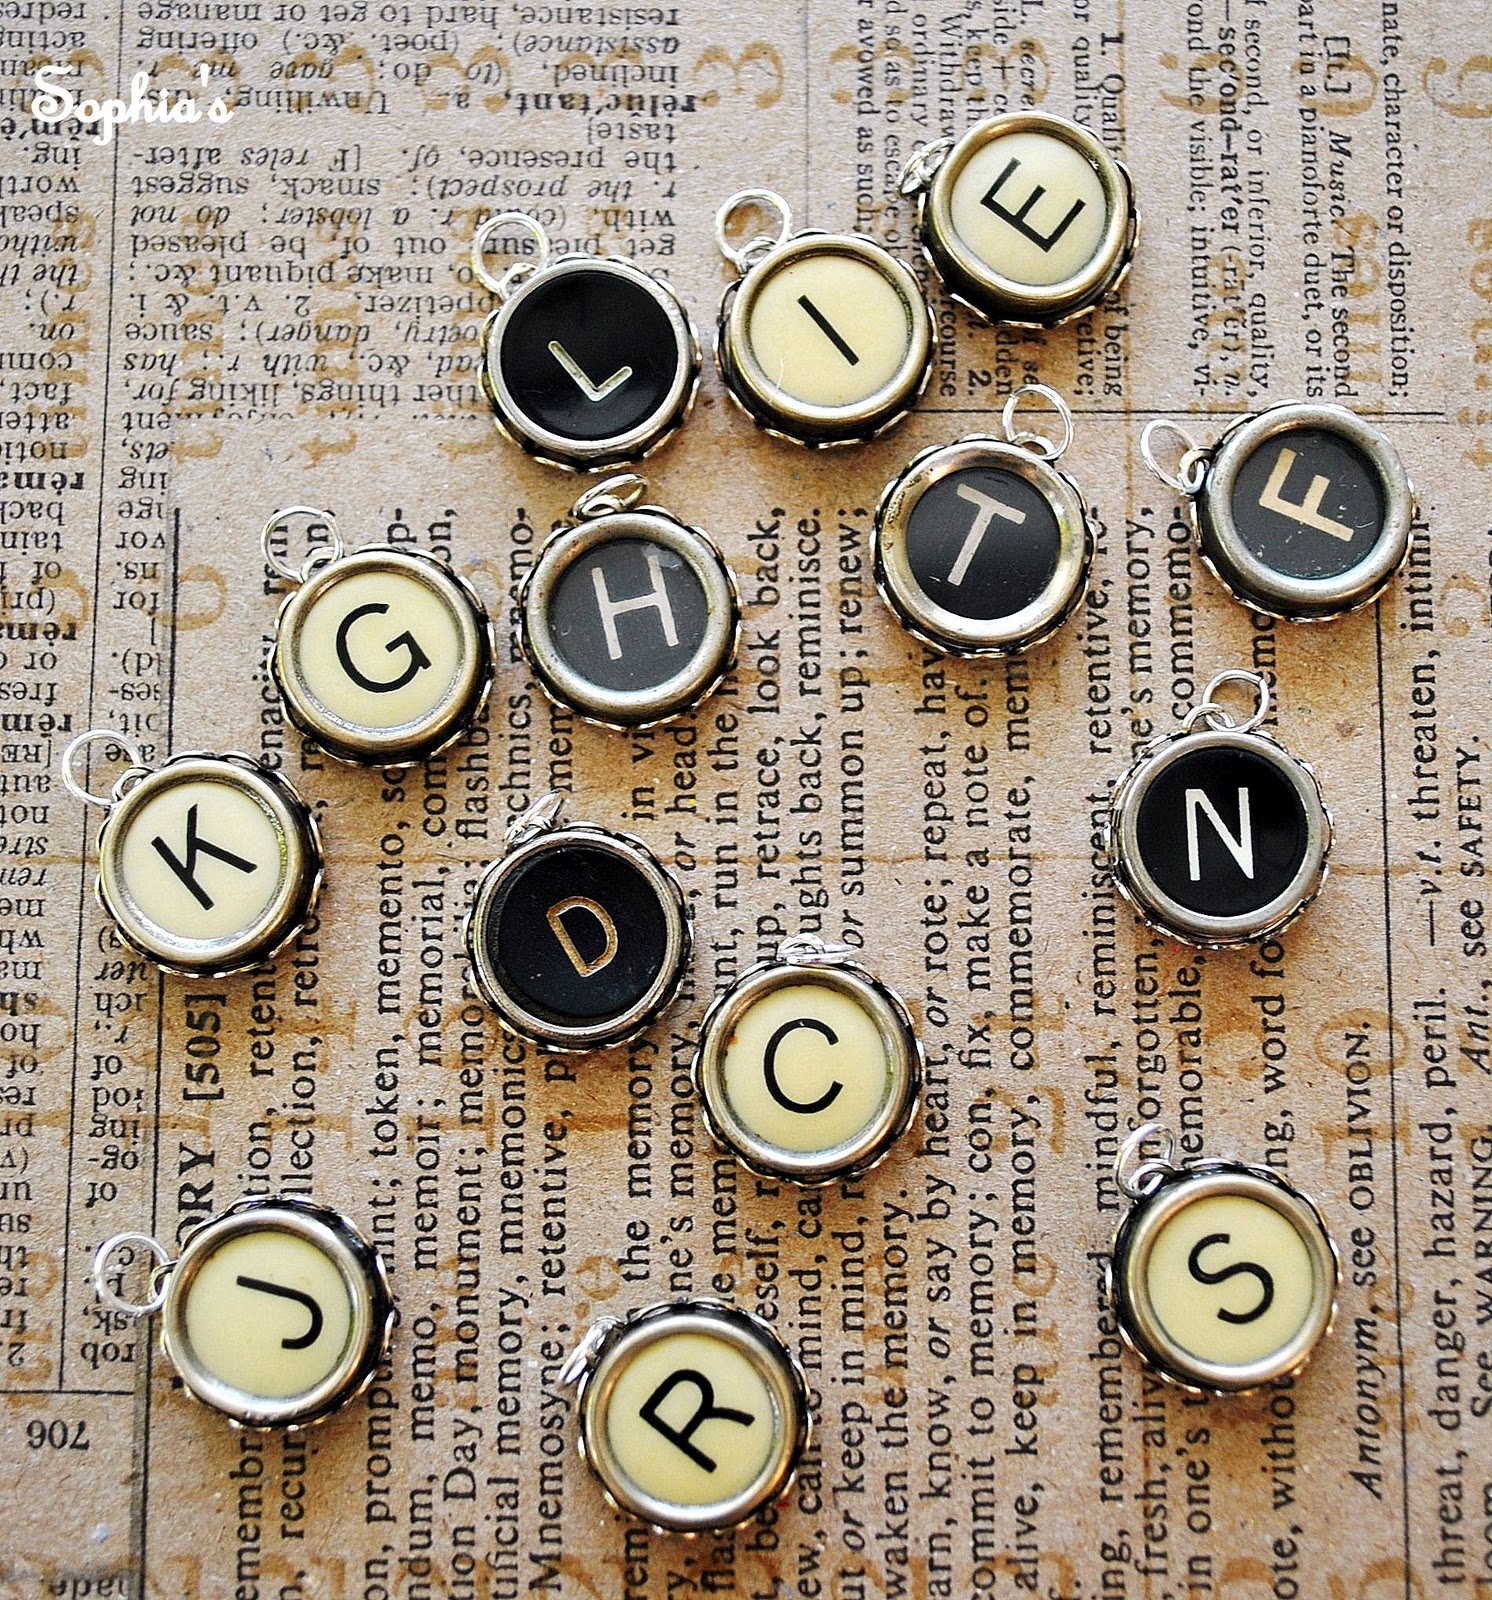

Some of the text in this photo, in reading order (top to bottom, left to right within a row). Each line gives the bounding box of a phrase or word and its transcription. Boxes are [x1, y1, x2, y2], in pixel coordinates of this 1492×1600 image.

[137, 28, 458, 58] (poet. &c.) offering
[138, 0, 679, 33] resistance, hard to get or manage
[857, 19, 881, 115] avowed
[543, 64, 679, 88] inclined,
[910, 14, 935, 127] ordinary
[134, 145, 676, 175] the presence, of. reles after-
[588, 113, 675, 144] taste]
[1329, 131, 1352, 229] Music.
[131, 203, 371, 230] lobster; do not
[132, 171, 631, 203] the prospect); smack, suggest
[980, 159, 1084, 252] E
[1187, 121, 1216, 349] visible; intuitive,
[1242, 20, 1274, 397] second, inferior, quality,
[1383, 73, 1415, 397] character or disposition;
[129, 260, 433, 288] make piquant &c.;
[131, 229, 675, 260] get out be pleased
[1299, 108, 1330, 397] pianoforte duet, or its
[1331, 245, 1356, 297] The
[126, 320, 369, 348] danger); sauce
[202, 289, 262, 315] v.t.
[798, 294, 862, 366] I
[1332, 308, 1358, 397] second
[124, 353, 328, 377] with has
[125, 376, 400, 408] things, liking for,
[548, 339, 633, 402] L
[1103, 324, 1129, 396] being
[947, 483, 1026, 586] T
[1258, 450, 1354, 542] F
[591, 555, 679, 661] H
[747, 508, 785, 607] back,
[335, 603, 432, 694] G
[746, 630, 780, 714] look
[1405, 650, 1441, 821] threaten,
[151, 804, 257, 910] K
[701, 714, 741, 909] run in the
[751, 737, 785, 880] retrace,
[1184, 787, 1254, 881] N
[545, 896, 618, 977] D
[788, 508, 828, 1370] mind, back, reminisce.
[1074, 580, 1129, 1213] mindful, retentive,
[1455, 736, 1492, 1075] Ant., see SAFETY.
[365, 821, 410, 1158] token, memento,
[658, 713, 700, 1198] memory, or head.
[182, 994, 227, 1101] [505]
[615, 787, 658, 1282] the in
[763, 1018, 843, 1115] C
[831, 508, 872, 1554] or keep in mind, or summon up; renew;
[954, 679, 1001, 1436] to memory; con, fix, make a note of.
[1126, 508, 1172, 1578] fresh, memory,
[1163, 505, 1212, 1591] in one's commemo-
[1412, 988, 1457, 1089] peril.
[411, 867, 452, 1441] memo, memoir; memorial,
[915, 731, 959, 1500] know, or say by heart, or rote; repeat,
[1003, 776, 1050, 1592] alive, keep in memory, commemorate,
[1418, 1107, 1458, 1258] hazard,
[1187, 1234, 1274, 1325] S
[1341, 1018, 1387, 1501] Antonym, see OBLIVION.
[236, 1276, 322, 1349] J
[443, 1147, 488, 1502] Day, monument;
[529, 1106, 575, 1592] Mnemosyne; retentive,
[875, 1190, 917, 1449] the memory.
[1427, 1279, 1466, 1431] danger,
[497, 1276, 529, 1455] memory,
[26, 1420, 90, 1451] 706
[638, 1369, 755, 1473] R
[1431, 1450, 1469, 1584] threat,
